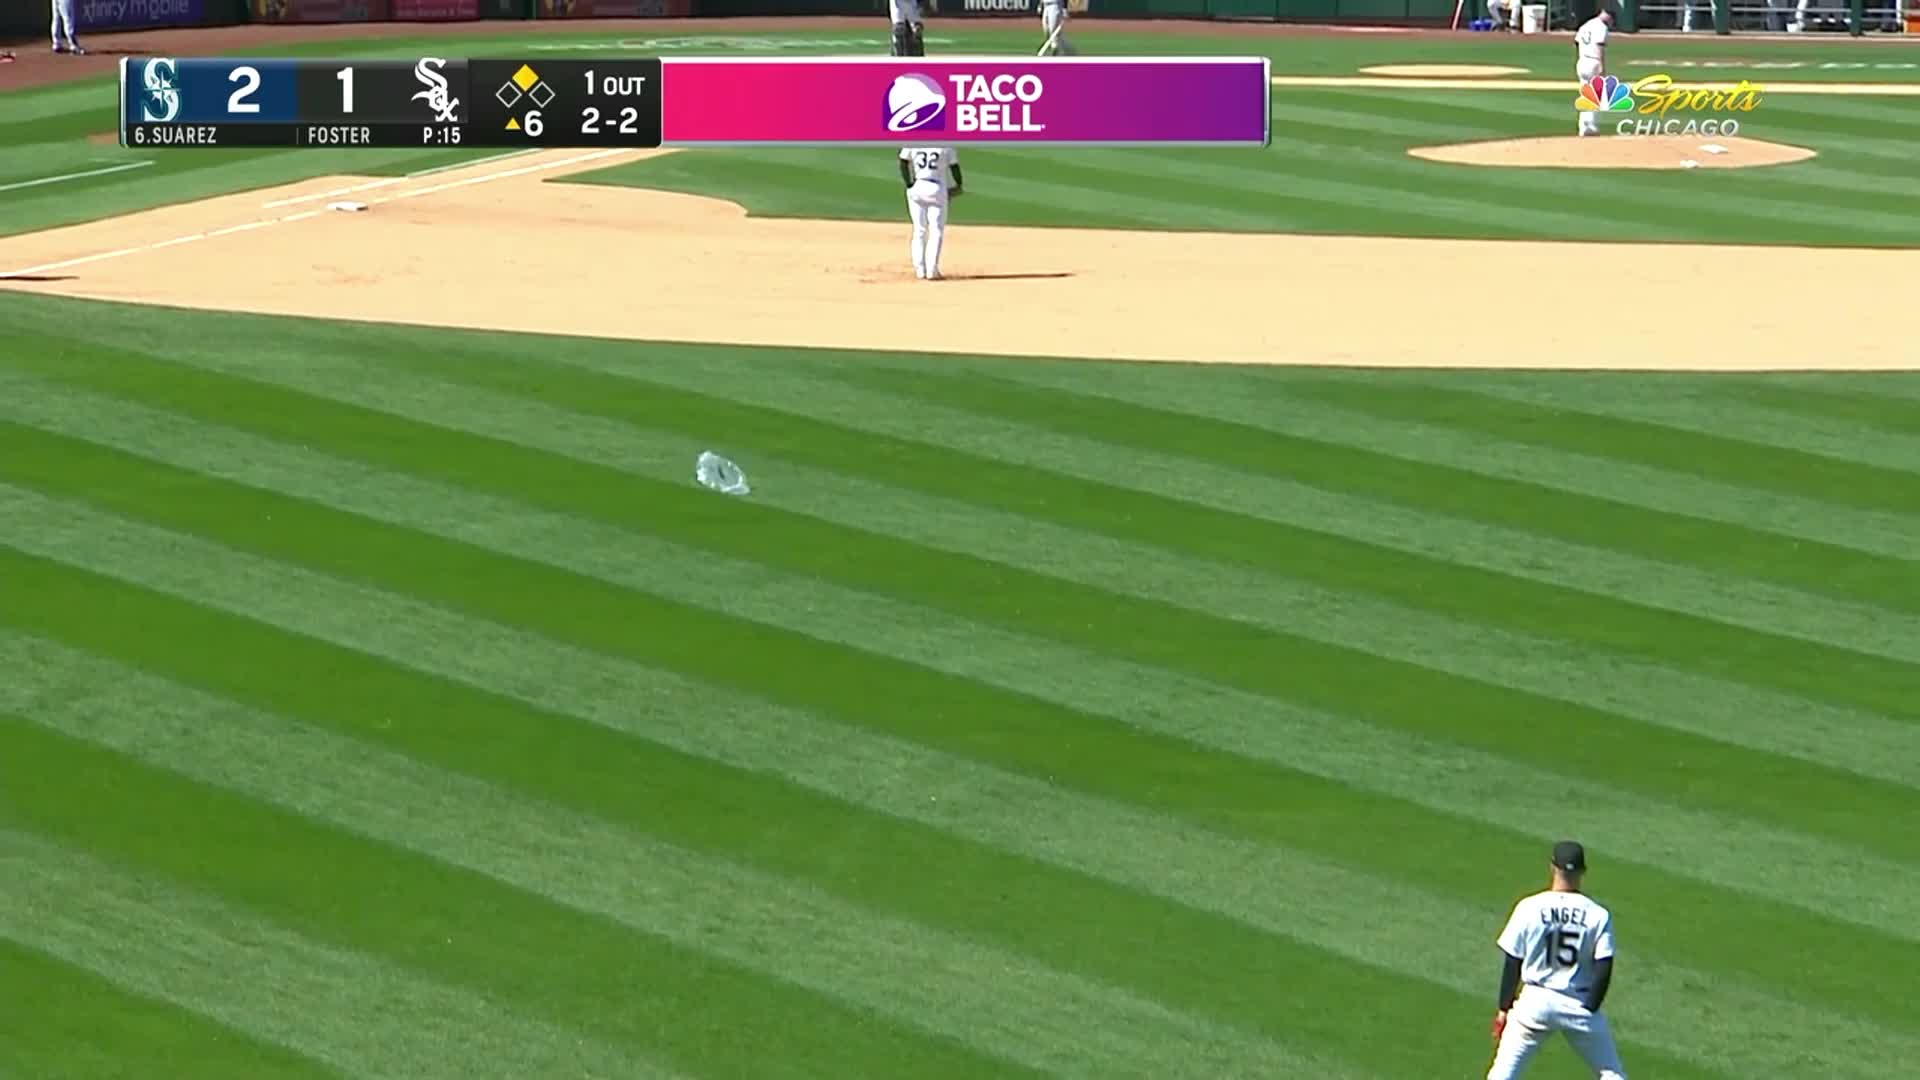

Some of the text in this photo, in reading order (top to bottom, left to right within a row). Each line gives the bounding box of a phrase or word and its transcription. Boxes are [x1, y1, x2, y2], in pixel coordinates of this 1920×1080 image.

[915, 151, 940, 170] 32
[1540, 907, 1589, 928] ENGEL
[1543, 931, 1580, 967] 15
